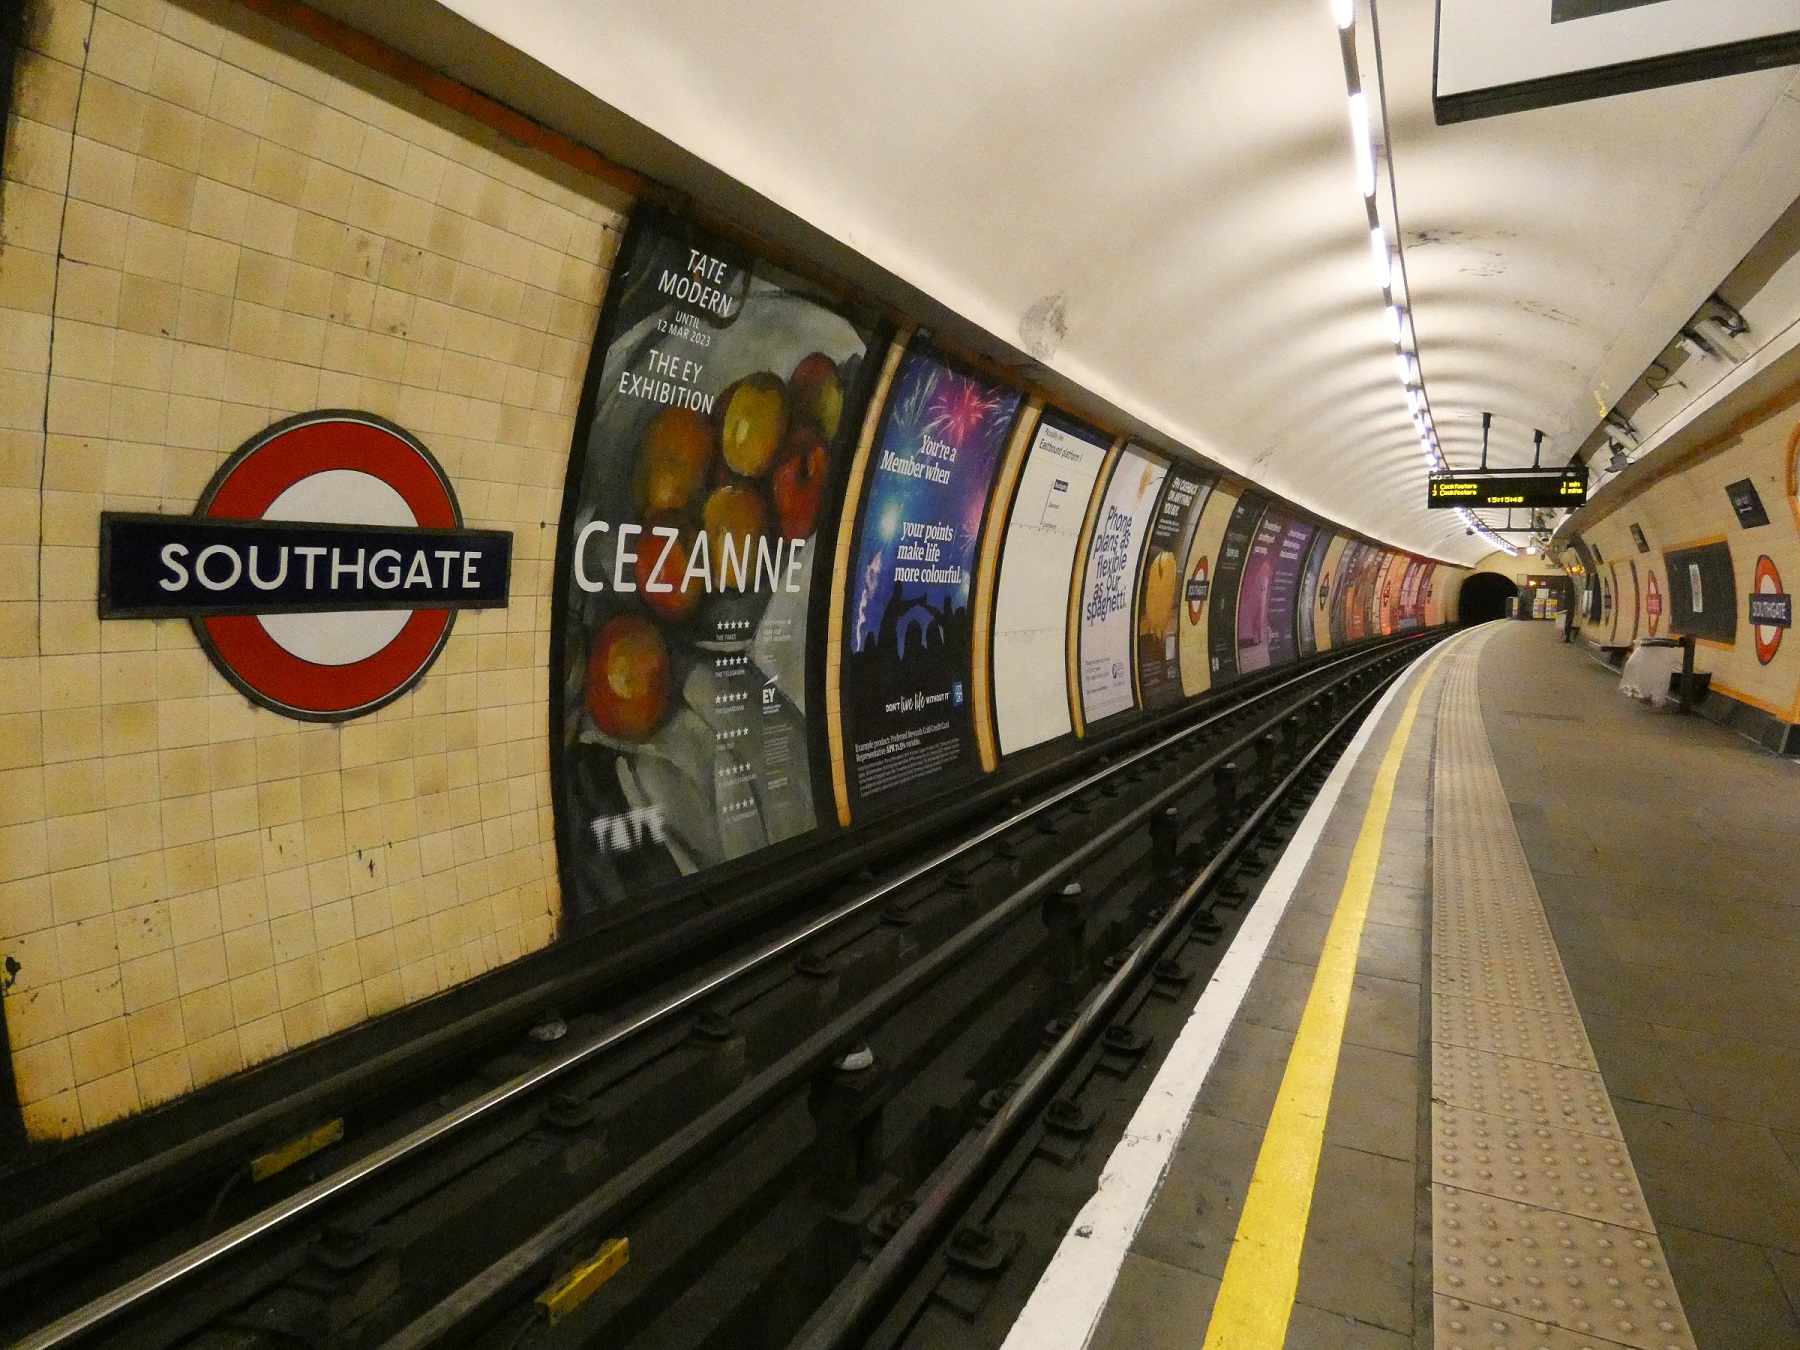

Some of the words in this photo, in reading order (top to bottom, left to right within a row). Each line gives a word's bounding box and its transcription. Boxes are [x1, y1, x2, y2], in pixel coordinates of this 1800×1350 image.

[688, 249, 727, 284] TATE
[658, 269, 732, 317] MODERN
[657, 318, 669, 332] 12
[668, 324, 690, 340] MAR
[690, 329, 711, 347] 2023
[675, 311, 700, 330] UNTIL
[649, 349, 679, 378] THE
[682, 360, 703, 384] EY
[618, 371, 714, 415] EXHIBITION
[920, 434, 950, 460] You're
[949, 447, 957, 462] a
[880, 449, 926, 478] Member
[925, 462, 951, 485] when
[901, 520, 926, 541] your
[925, 521, 954, 544] points
[1107, 504, 1132, 533] Phone
[574, 520, 806, 594] CEZANNE
[897, 542, 924, 562] make
[925, 543, 941, 562] life
[1093, 532, 1119, 560] plans
[1119, 530, 1131, 549] as
[158, 543, 482, 591] SOUTHGATE
[894, 566, 920, 582] more
[920, 564, 962, 584] colourful.
[1096, 552, 1127, 580] flexible
[1093, 582, 1104, 601] as
[1106, 574, 1121, 592] our
[1086, 585, 1127, 627] spaghetti.
[1752, 601, 1786, 620] SOUTHGATE
[762, 688, 776, 704] EY
[900, 695, 914, 713] live
[914, 691, 926, 712] life
[925, 693, 943, 705] WITHOUT
